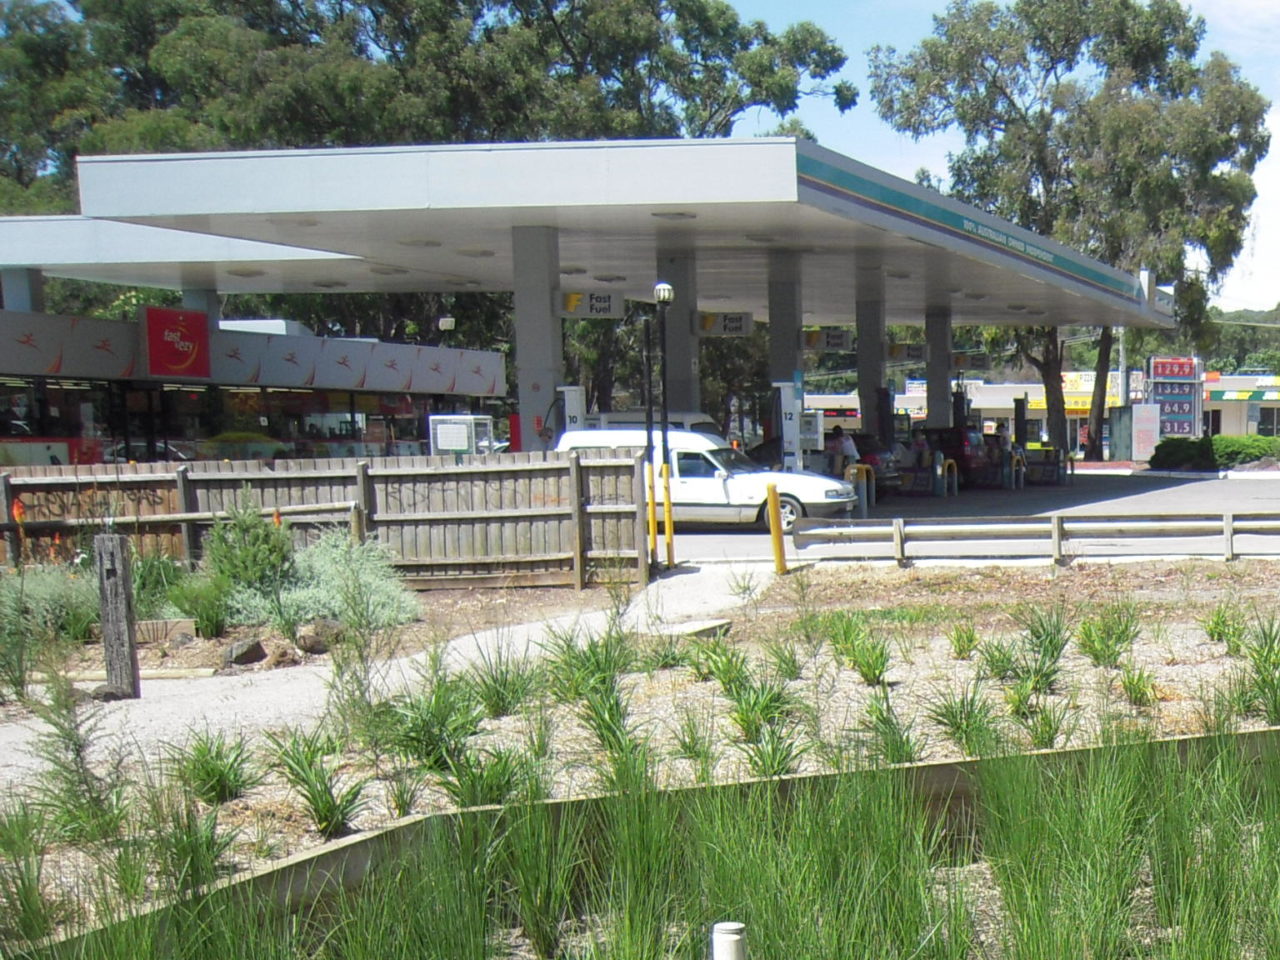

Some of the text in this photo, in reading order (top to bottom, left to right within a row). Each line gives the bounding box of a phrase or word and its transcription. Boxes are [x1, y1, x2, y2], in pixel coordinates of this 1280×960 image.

[589, 293, 611, 303] Fast
[589, 304, 611, 313] Fuel
[723, 315, 743, 323] Fast
[723, 324, 743, 332] Fuel
[1157, 364, 1191, 375] 129.9
[1158, 384, 1190, 394] 133.9
[1164, 403, 1190, 413] 64.9
[568, 415, 577, 424] 10
[784, 412, 793, 420] 12
